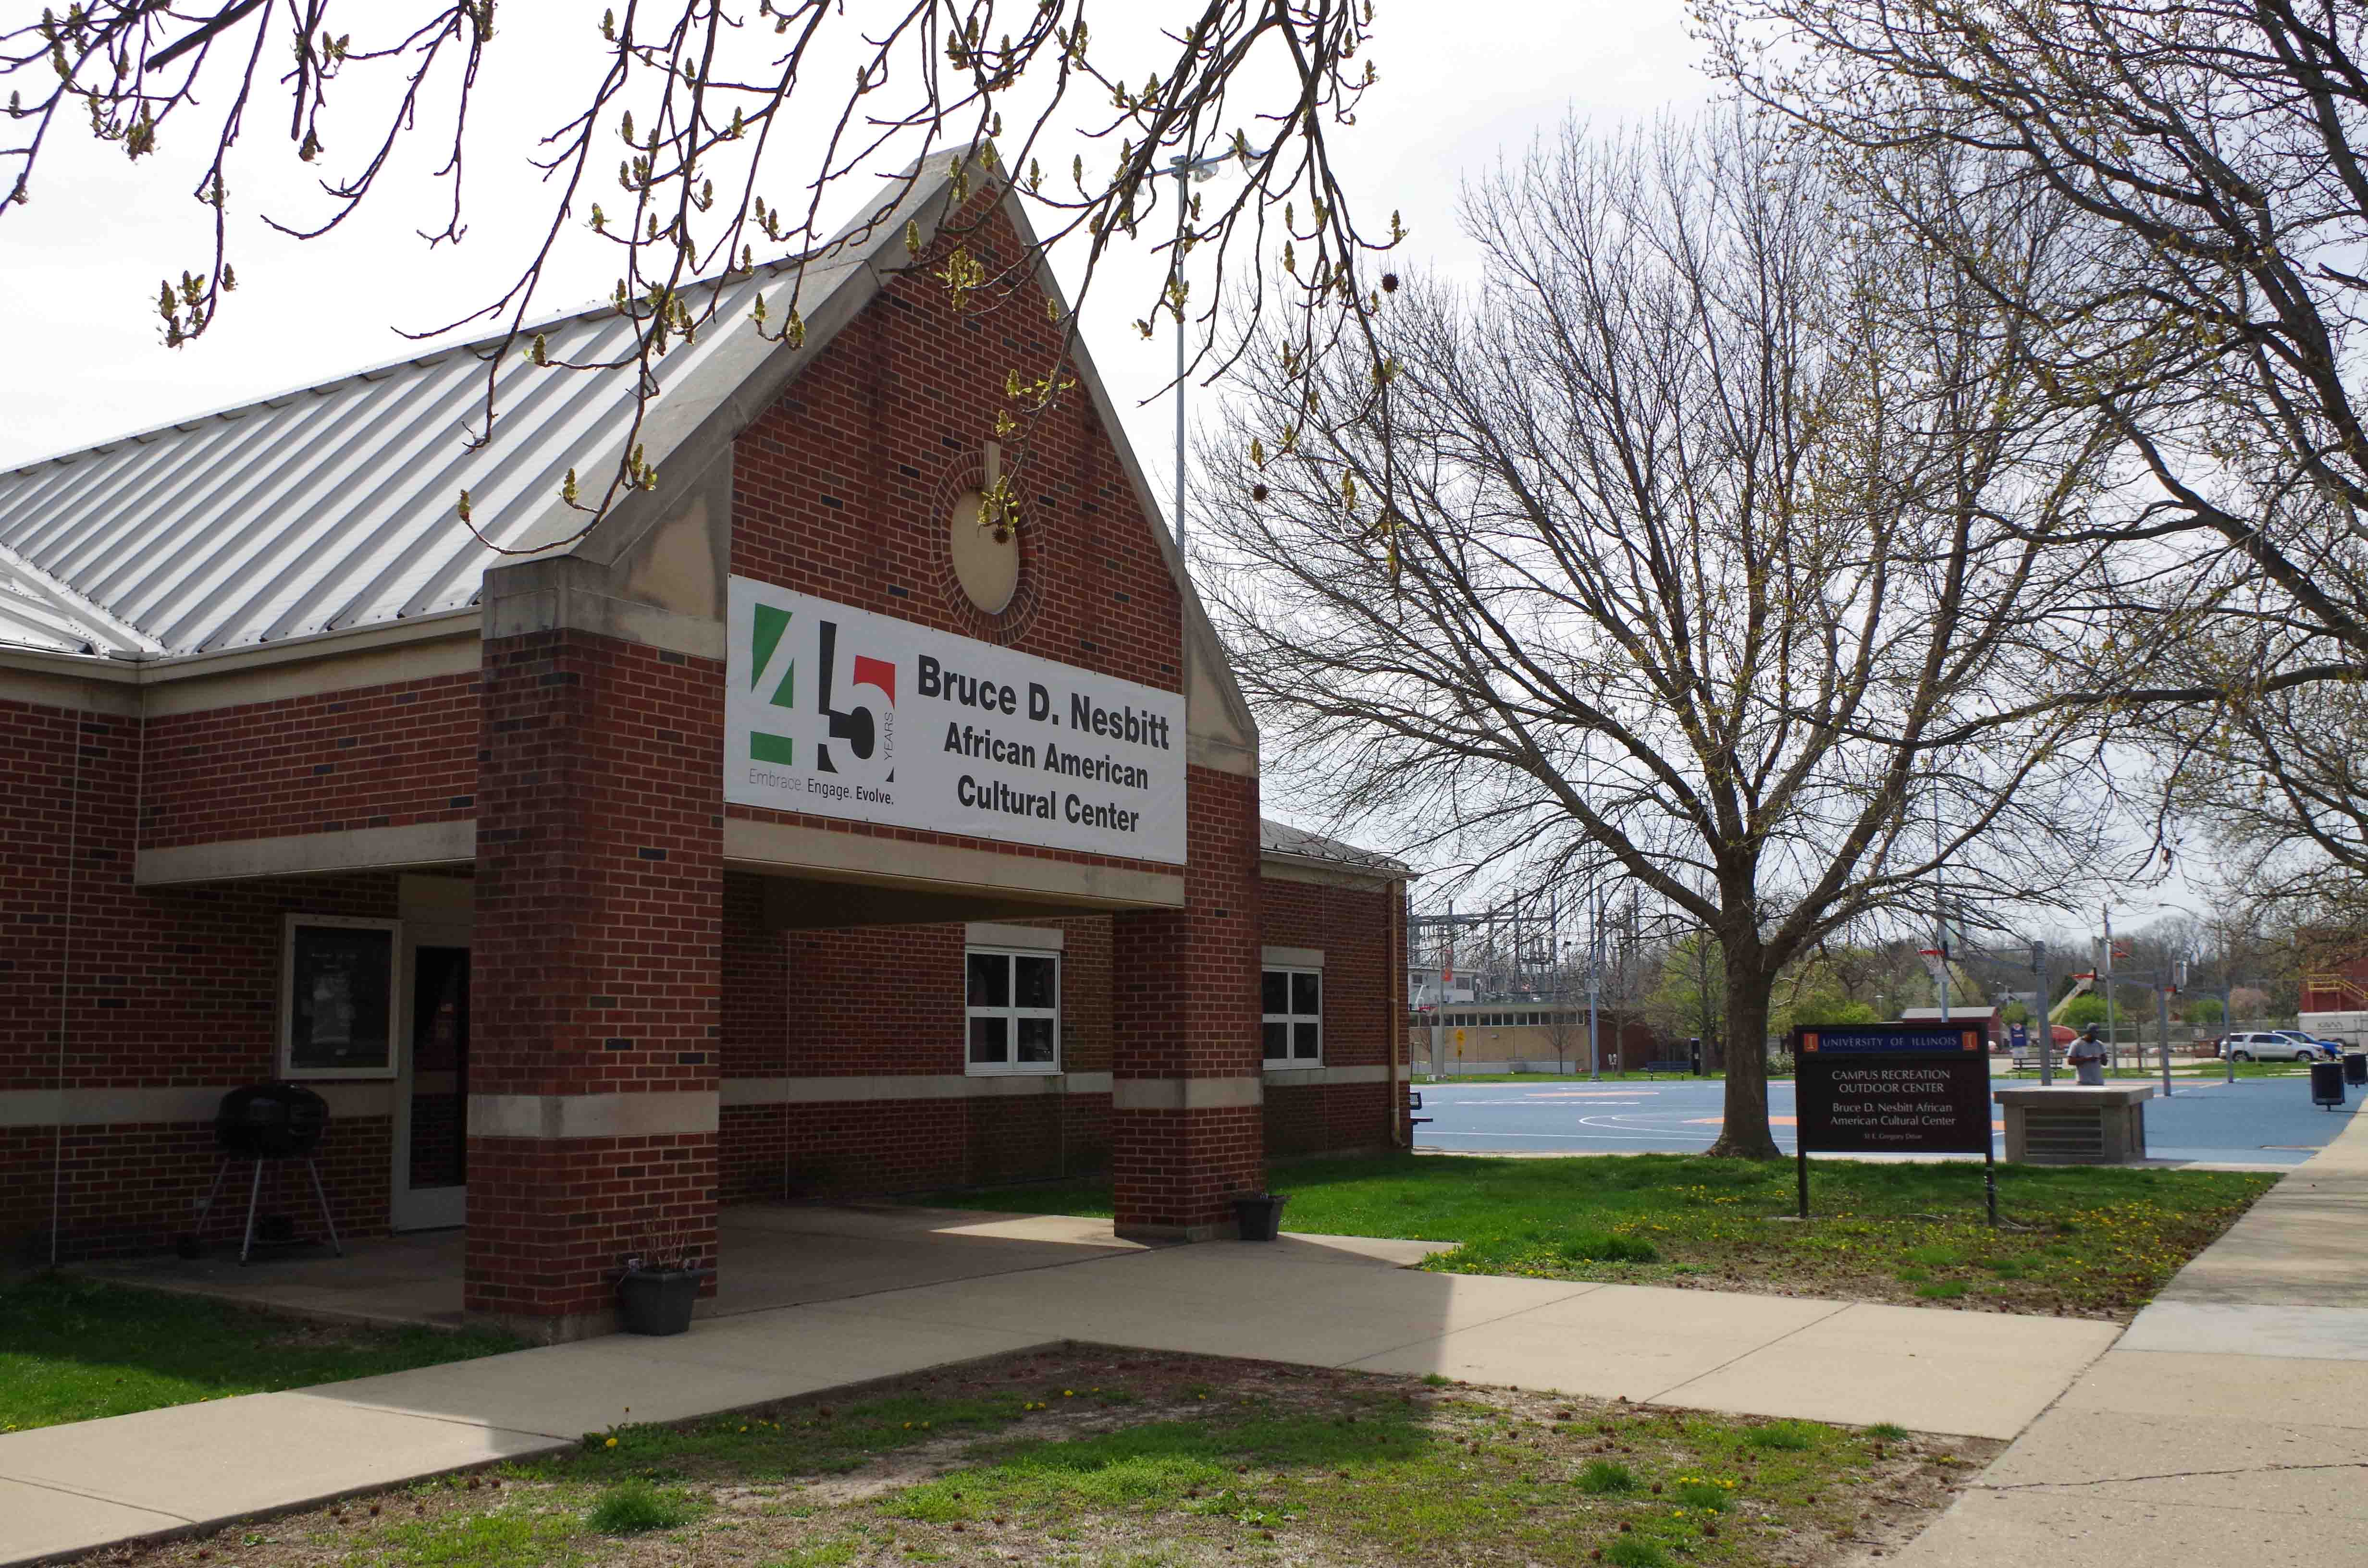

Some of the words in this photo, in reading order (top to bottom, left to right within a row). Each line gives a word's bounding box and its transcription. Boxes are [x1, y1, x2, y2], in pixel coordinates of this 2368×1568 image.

[918, 654, 1017, 715] Bruce
[1029, 681, 1059, 726] D.
[1071, 692, 1169, 750] Nesbitt
[884, 712, 894, 760] YEARS
[944, 722, 1036, 769] African
[1043, 743, 1148, 790] American
[749, 769, 803, 792] Embrace.
[808, 778, 852, 801] Engage.
[856, 786, 894, 805] Evolve.
[957, 775, 1056, 821] Cultural
[1064, 793, 1139, 833] Center
[1823, 1037, 1883, 1046] UNIVERSITY
[1890, 1037, 1903, 1046] OF
[1912, 1037, 1957, 1046] ILLINOIS
[1832, 1070, 1879, 1080] CAMPUS
[1881, 1069, 1950, 1080] RECREATION
[1839, 1083, 1899, 1093] OUTDOOR
[1902, 1083, 1944, 1093] CENTER
[1833, 1103, 1861, 1112] Bruce
[1864, 1103, 1874, 1112] D.
[1878, 1102, 1913, 1112] Nesbitt
[1916, 1102, 1952, 1112] African
[1831, 1115, 1878, 1126] American
[1880, 1115, 1919, 1126] Cultural
[1922, 1115, 1956, 1126] Center
